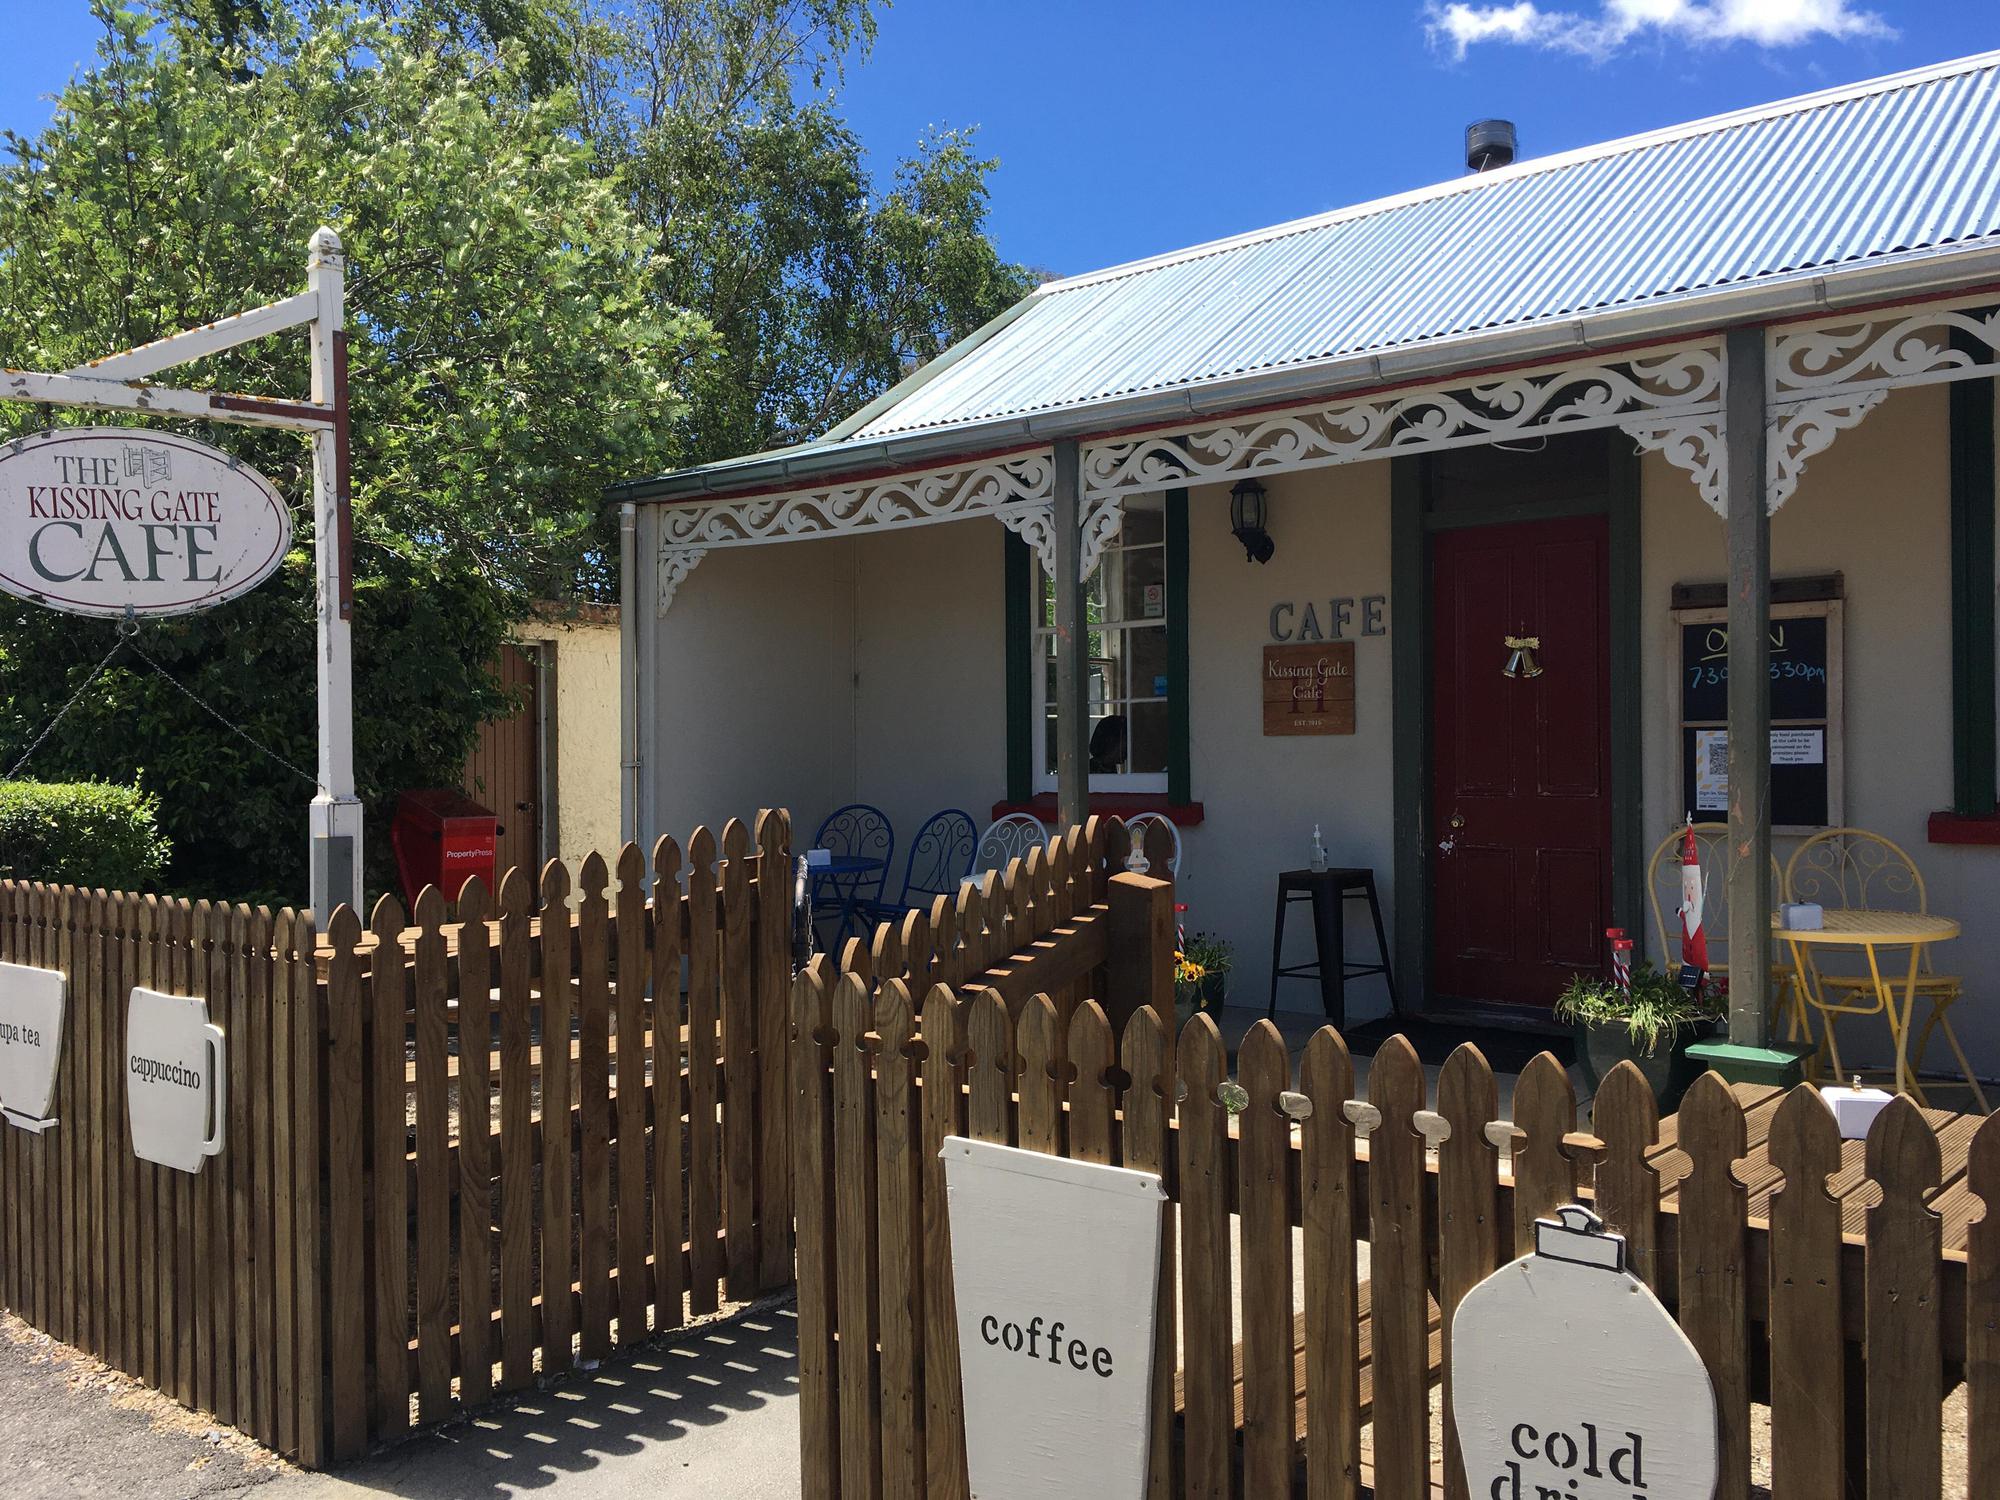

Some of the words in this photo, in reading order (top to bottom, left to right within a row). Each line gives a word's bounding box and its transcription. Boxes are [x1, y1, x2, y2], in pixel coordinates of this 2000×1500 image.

[54, 455, 119, 486] THE
[27, 486, 143, 521] KISSING
[150, 490, 221, 523] GATE
[28, 521, 222, 583] CAFE
[1269, 595, 1386, 641] CAFE
[1268, 659, 1313, 687] Kissing
[1317, 657, 1348, 685] Gate
[446, 849, 493, 858] PropertyPress
[22, 1024, 41, 1047] tea
[130, 1054, 201, 1090] cappuccino
[981, 1315, 1114, 1378] coffee
[1511, 1422, 1648, 1489] cold
